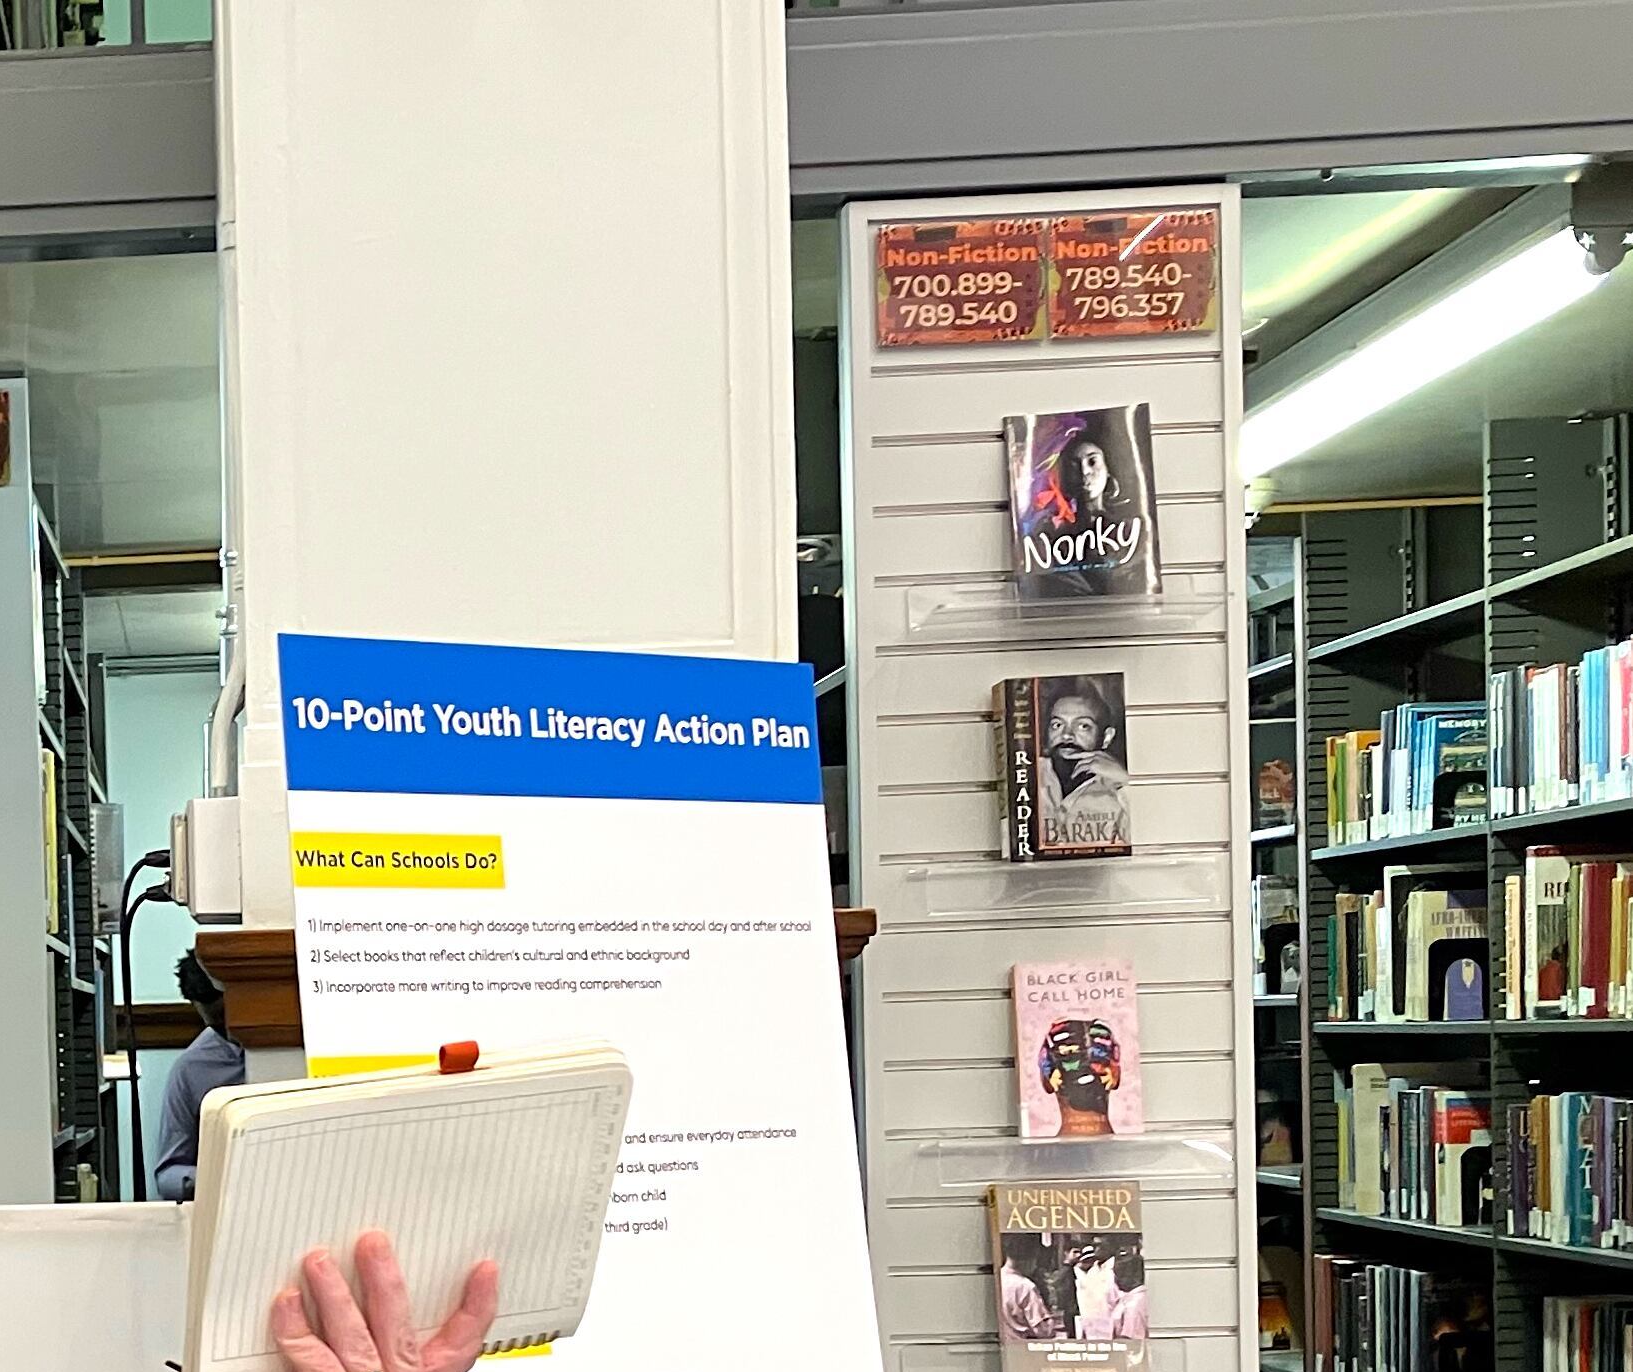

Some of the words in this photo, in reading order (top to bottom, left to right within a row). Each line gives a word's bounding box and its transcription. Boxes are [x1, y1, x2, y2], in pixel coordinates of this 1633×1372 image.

[886, 242, 1038, 268] Non-Fiction
[893, 271, 1023, 299] 700.899-
[1066, 263, 1192, 291] 789.540-
[899, 300, 1018, 328] 789.540
[1073, 292, 1185, 320] 796.357
[292, 697, 426, 734] 10-Point
[433, 703, 522, 738] Youth
[530, 708, 644, 747] Literacy
[654, 713, 744, 746] Action
[753, 717, 810, 749] Plan
[1015, 751, 1034, 856] READER
[1044, 818, 1125, 845] BARAKA
[296, 850, 345, 868] What
[352, 851, 385, 868] Can
[392, 852, 460, 869] Schools
[465, 853, 497, 869] Do?
[308, 919, 316, 933] 1)
[319, 919, 383, 935] Implement
[386, 922, 457, 932] one-on-one
[460, 920, 484, 935] high
[488, 920, 529, 935] dosage
[532, 921, 576, 935] tutoring
[578, 921, 638, 932] embedded
[641, 921, 650, 932] in
[652, 921, 669, 932] the
[672, 921, 706, 932] school
[708, 921, 728, 934] day
[730, 921, 750, 932] and
[753, 920, 777, 932] after
[780, 920, 812, 932] school
[310, 949, 321, 964] 2)
[324, 950, 361, 962] Select
[364, 950, 399, 962] books
[402, 950, 427, 962] that
[430, 950, 465, 962] reflect
[469, 949, 519, 962] children's
[523, 949, 564, 962] cultural
[567, 950, 588, 961] and
[591, 949, 624, 961] ethnic
[627, 949, 690, 964] background
[1027, 973, 1078, 986] BLACK
[1085, 971, 1129, 984] GIRL
[313, 980, 324, 994] 3)
[326, 980, 396, 997] Incorporate
[399, 982, 428, 993] more
[431, 980, 470, 995] writing
[472, 981, 485, 992] to
[487, 979, 532, 994] improve
[534, 979, 577, 993] reading
[580, 979, 662, 992] comprehension
[1027, 991, 1070, 1003] CALL
[1077, 987, 1126, 1000] HOME
[624, 1132, 646, 1144] and
[648, 1133, 684, 1143] ensure
[686, 1130, 735, 1144] everyday
[737, 1127, 797, 1140] attendance
[626, 1162, 646, 1173] ask
[648, 1160, 699, 1175] questions
[611, 1191, 639, 1203] born
[641, 1189, 667, 1202] child
[1007, 1189, 1132, 1206] UNFINISHED
[605, 1221, 630, 1234] third
[632, 1217, 668, 1235] grade)
[1006, 1206, 1135, 1229] AGENDA
